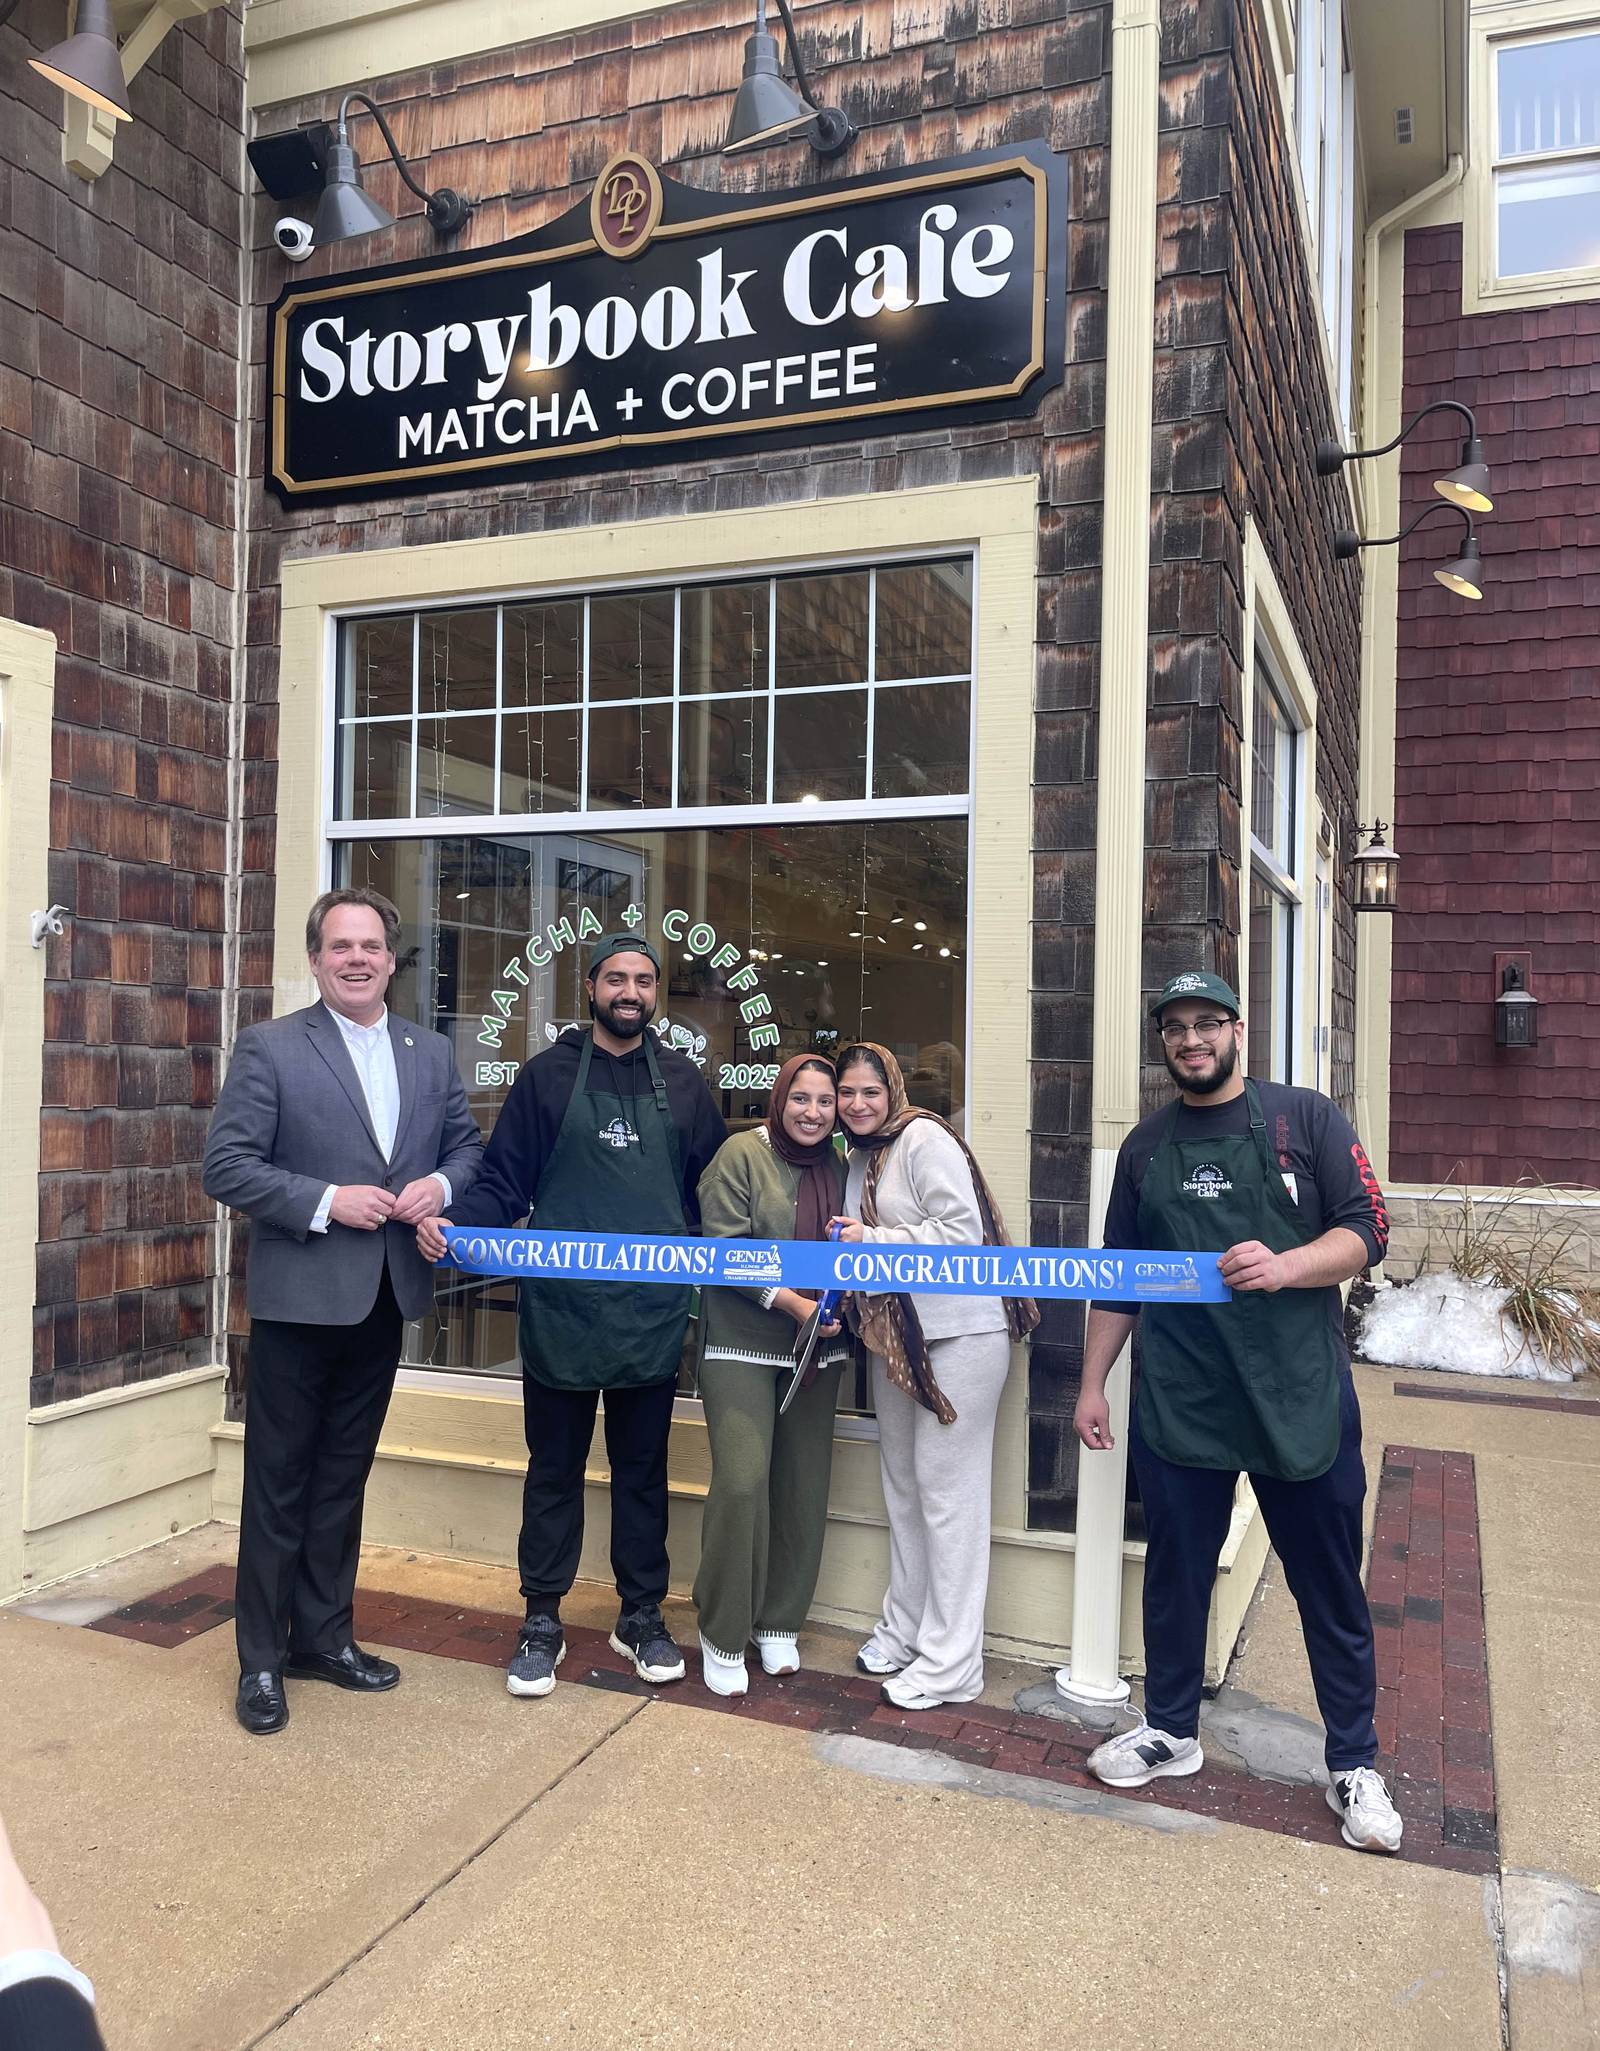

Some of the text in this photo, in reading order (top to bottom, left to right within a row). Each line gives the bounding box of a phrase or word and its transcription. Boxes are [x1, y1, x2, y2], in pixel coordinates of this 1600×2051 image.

[300, 204, 1015, 403] Storybook Cafe
[398, 342, 878, 459] MATCHA + COFFEE
[477, 907, 602, 1048] MATCHA
[663, 909, 780, 1051] COFFEE
[475, 1062, 781, 1090] EST 2025
[599, 1130, 640, 1141] Storybook
[1183, 1180, 1233, 1191] Storybook
[1197, 1188, 1220, 1198] Cafe
[451, 1237, 716, 1275] CONGRATULATIONS!
[725, 1245, 782, 1264] GENEVA
[1135, 1257, 1199, 1278] GENEVA
[834, 1253, 1124, 1289] CONGRATULATIONS!
